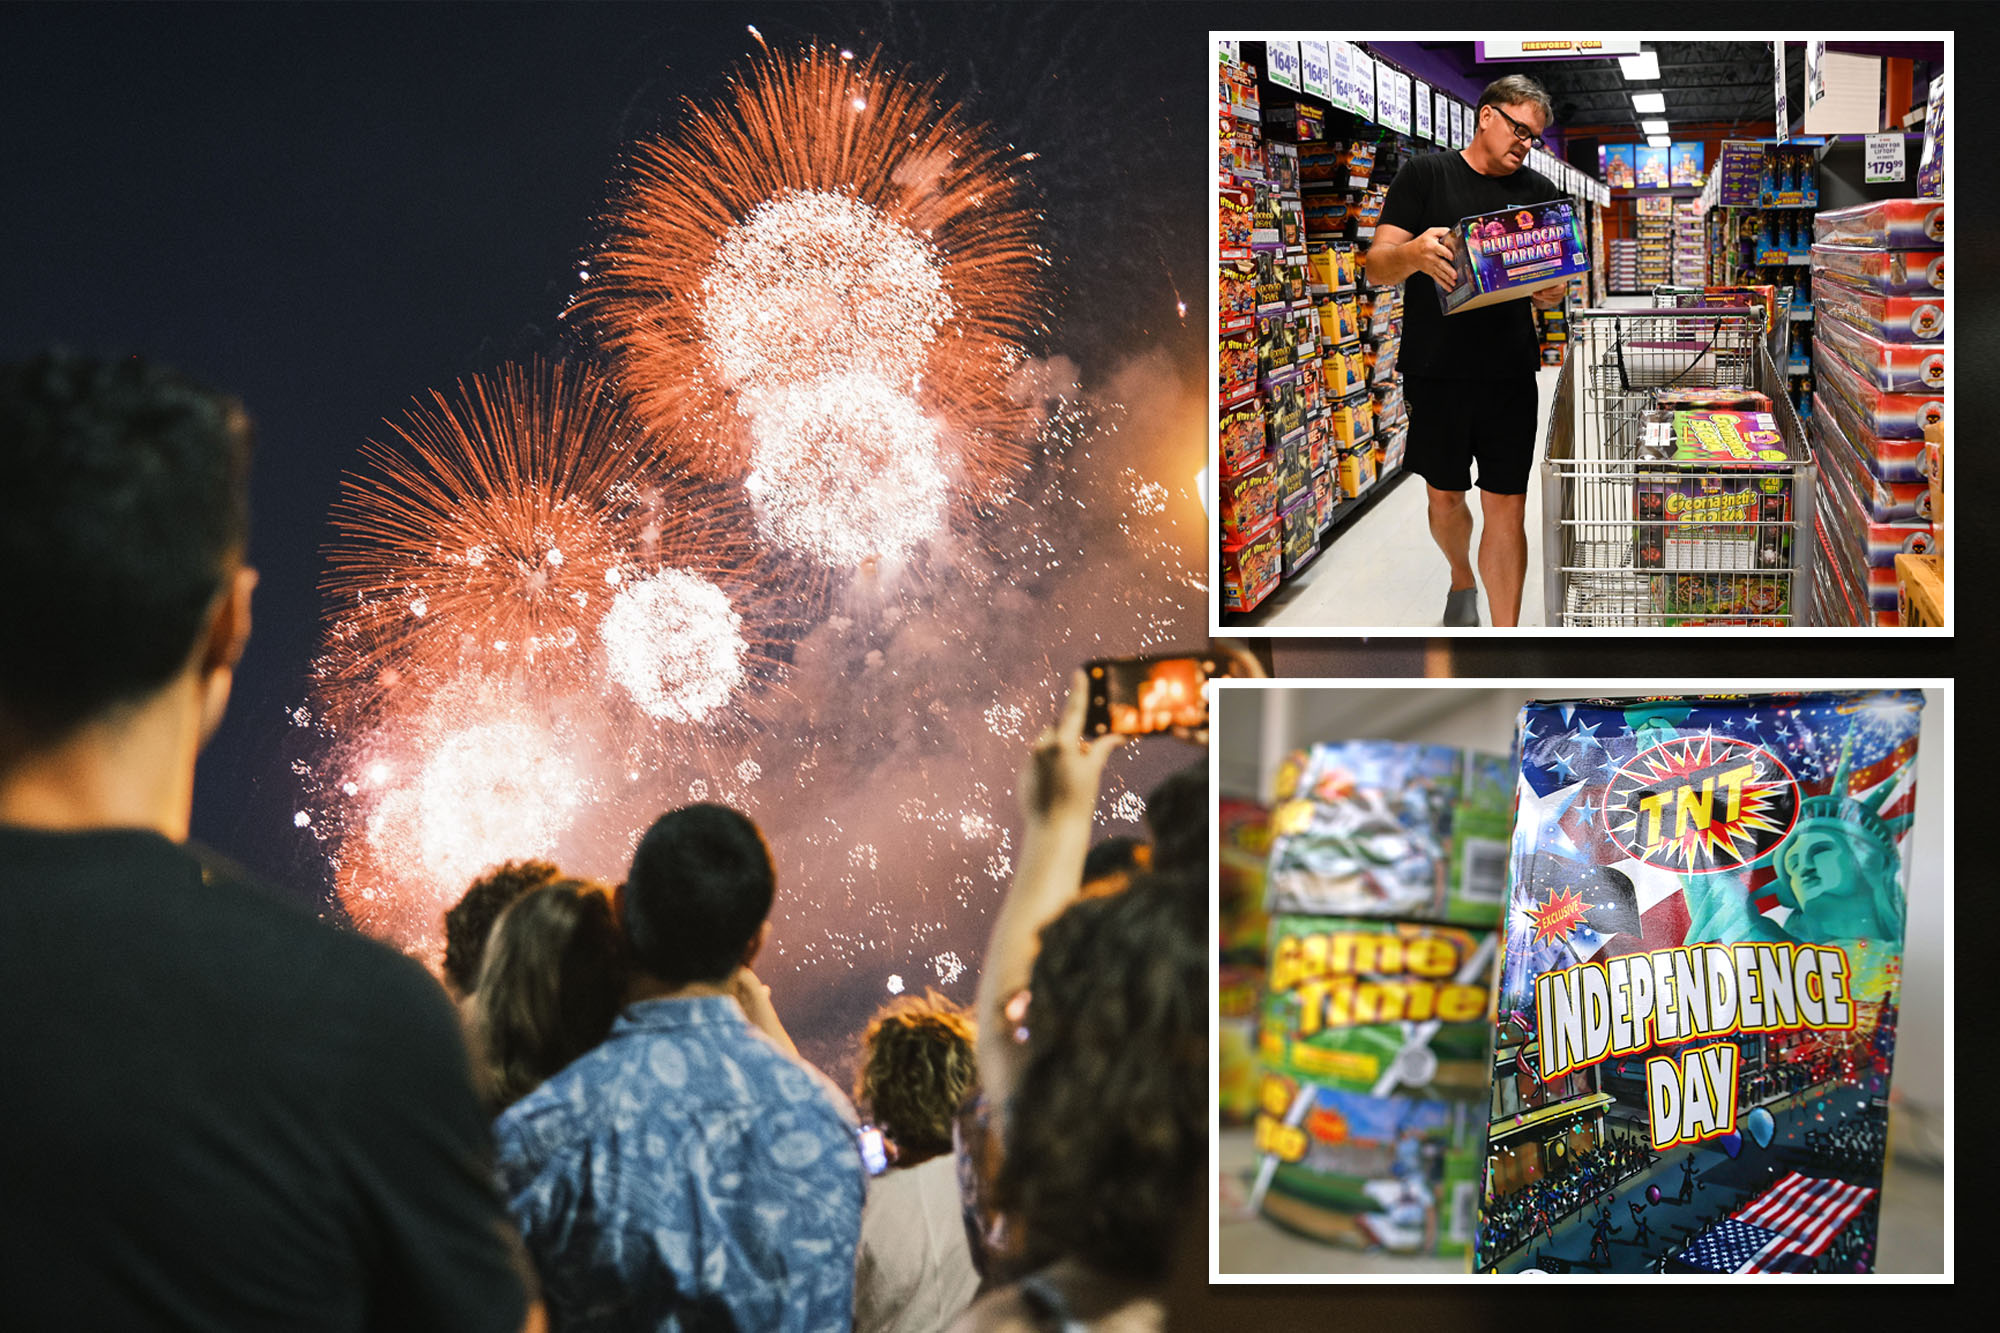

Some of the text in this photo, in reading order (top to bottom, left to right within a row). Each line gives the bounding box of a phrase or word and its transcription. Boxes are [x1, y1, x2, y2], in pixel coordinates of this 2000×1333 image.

[1522, 42, 1572, 51] FIREWORKS
[1482, 223, 1574, 255] BLUE BROCADE
[1502, 241, 1561, 266] BARRAGE
[1666, 489, 1757, 514] Geomagnetic
[1679, 508, 1745, 530] STORM
[1639, 762, 1755, 848] TNT
[1542, 900, 1579, 929] EXCLUSIVE
[1295, 975, 1490, 1037] Time
[1535, 943, 1851, 1079] INDEPENDENCE
[1647, 1044, 1739, 1147] DAY
